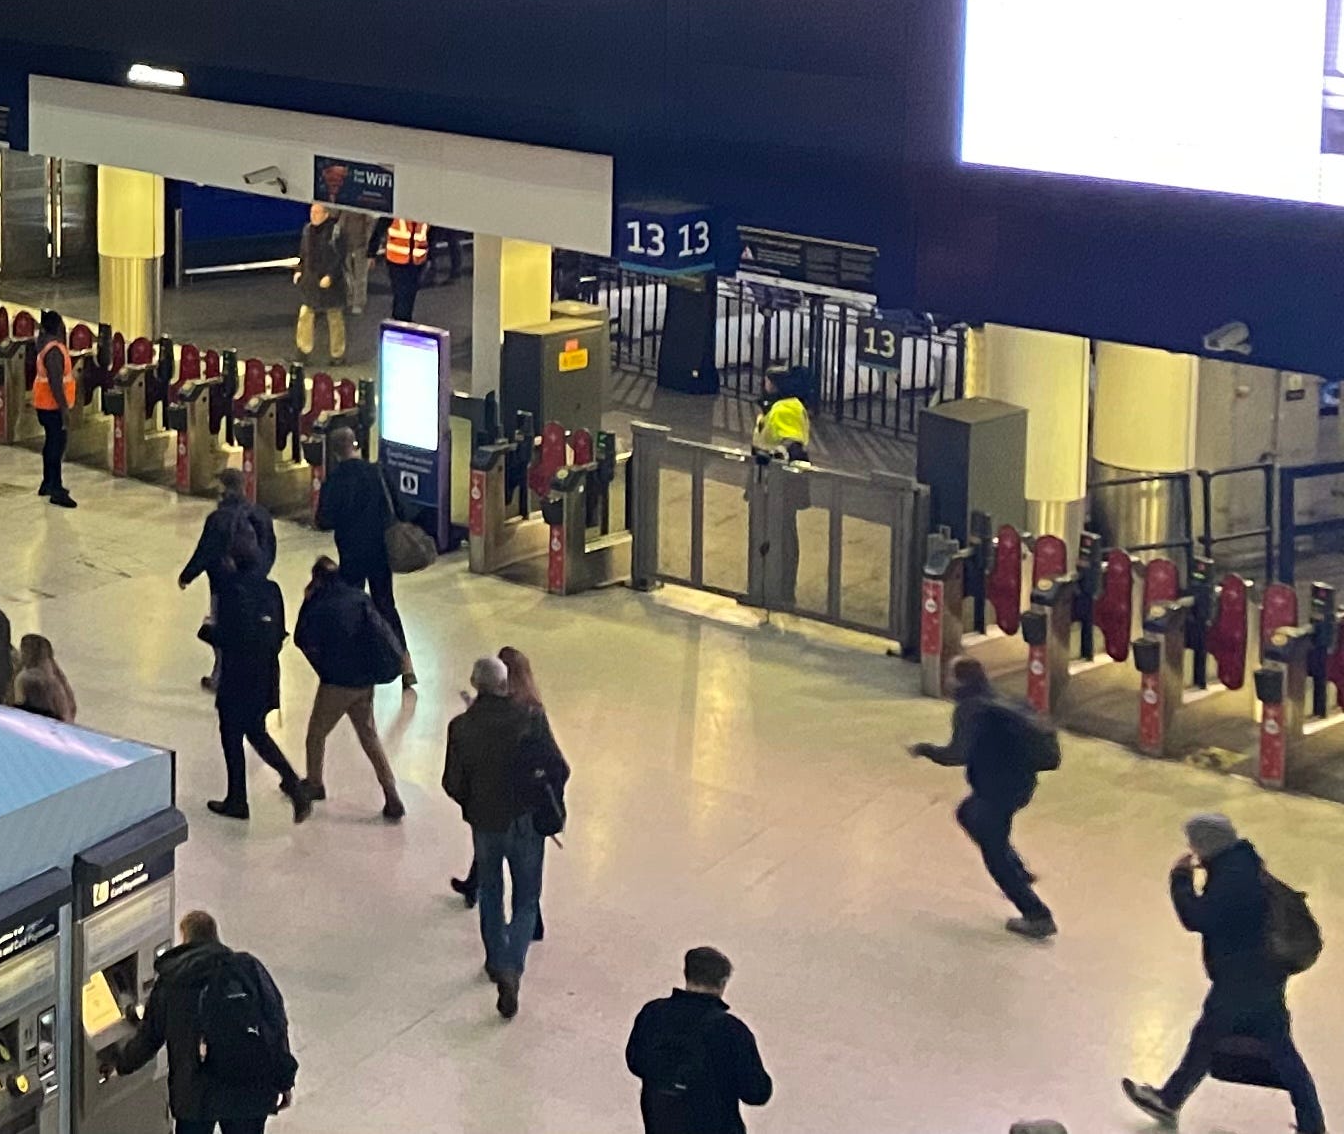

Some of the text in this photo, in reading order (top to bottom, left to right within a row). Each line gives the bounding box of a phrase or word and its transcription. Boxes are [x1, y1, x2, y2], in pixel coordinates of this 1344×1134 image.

[626, 221, 666, 257] 13
[678, 220, 710, 257] 13
[863, 326, 896, 359] 13
